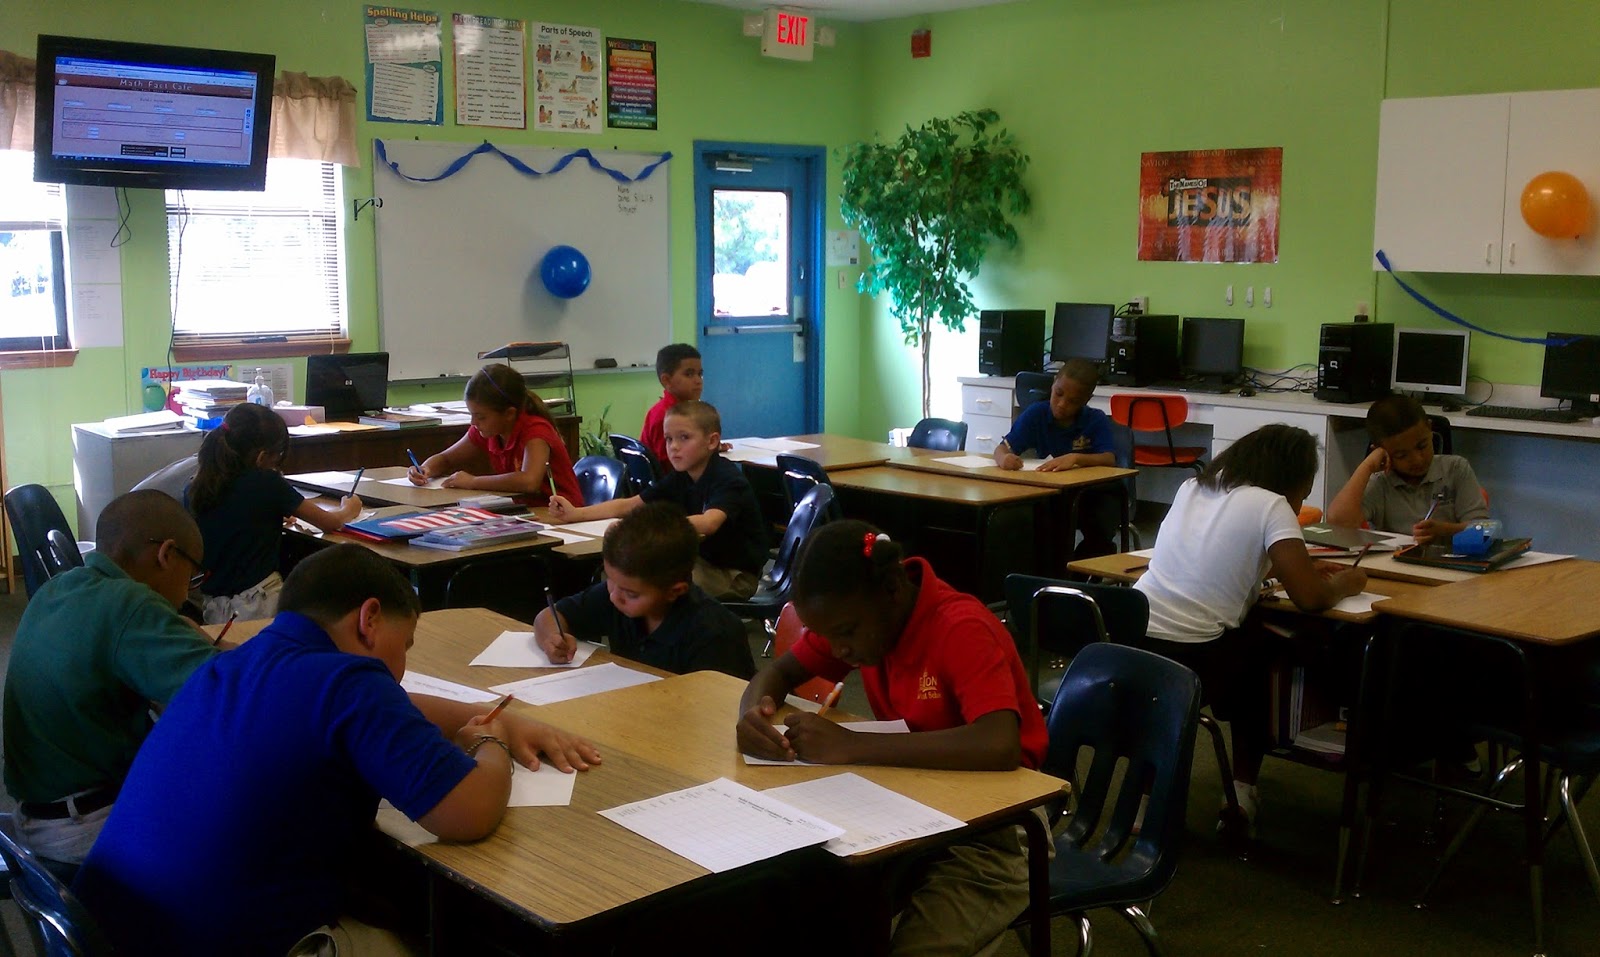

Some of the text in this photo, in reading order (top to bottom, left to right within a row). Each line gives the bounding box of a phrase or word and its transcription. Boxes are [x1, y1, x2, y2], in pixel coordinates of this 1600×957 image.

[367, 8, 438, 25] Spelling Helps
[541, 25, 593, 38] Parts of Speech
[777, 13, 808, 46] EXIT
[119, 79, 143, 87] Math
[148, 81, 168, 89] Fact
[172, 82, 193, 91] Cafe
[1168, 185, 1251, 220] JESUS
[150, 366, 226, 381] Happy Birthday!
